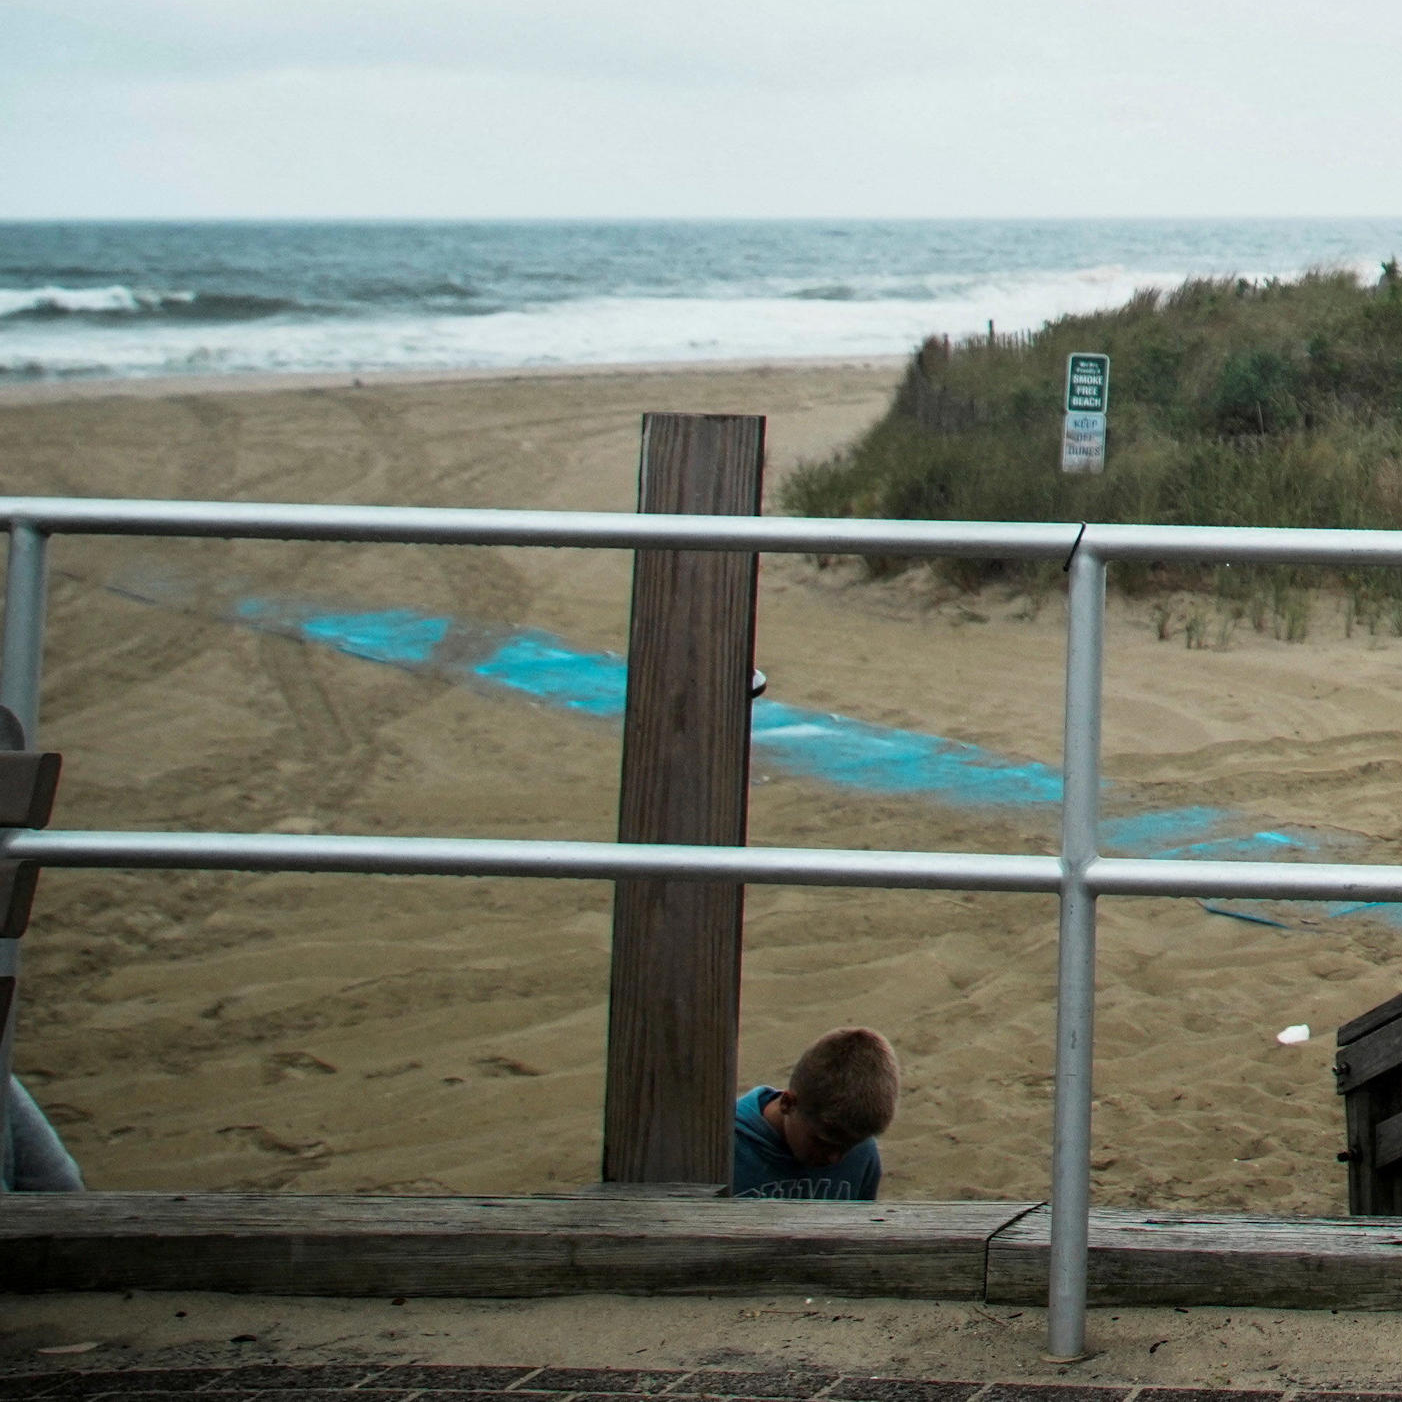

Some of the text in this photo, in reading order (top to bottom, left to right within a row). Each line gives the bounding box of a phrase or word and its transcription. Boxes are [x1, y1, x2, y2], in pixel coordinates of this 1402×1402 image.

[1073, 374, 1103, 385] SMOKE
[1076, 385, 1098, 395] FREE
[1072, 396, 1101, 407] BEACH
[1074, 419, 1097, 428] KEEP
[1068, 445, 1100, 455] DUNES
